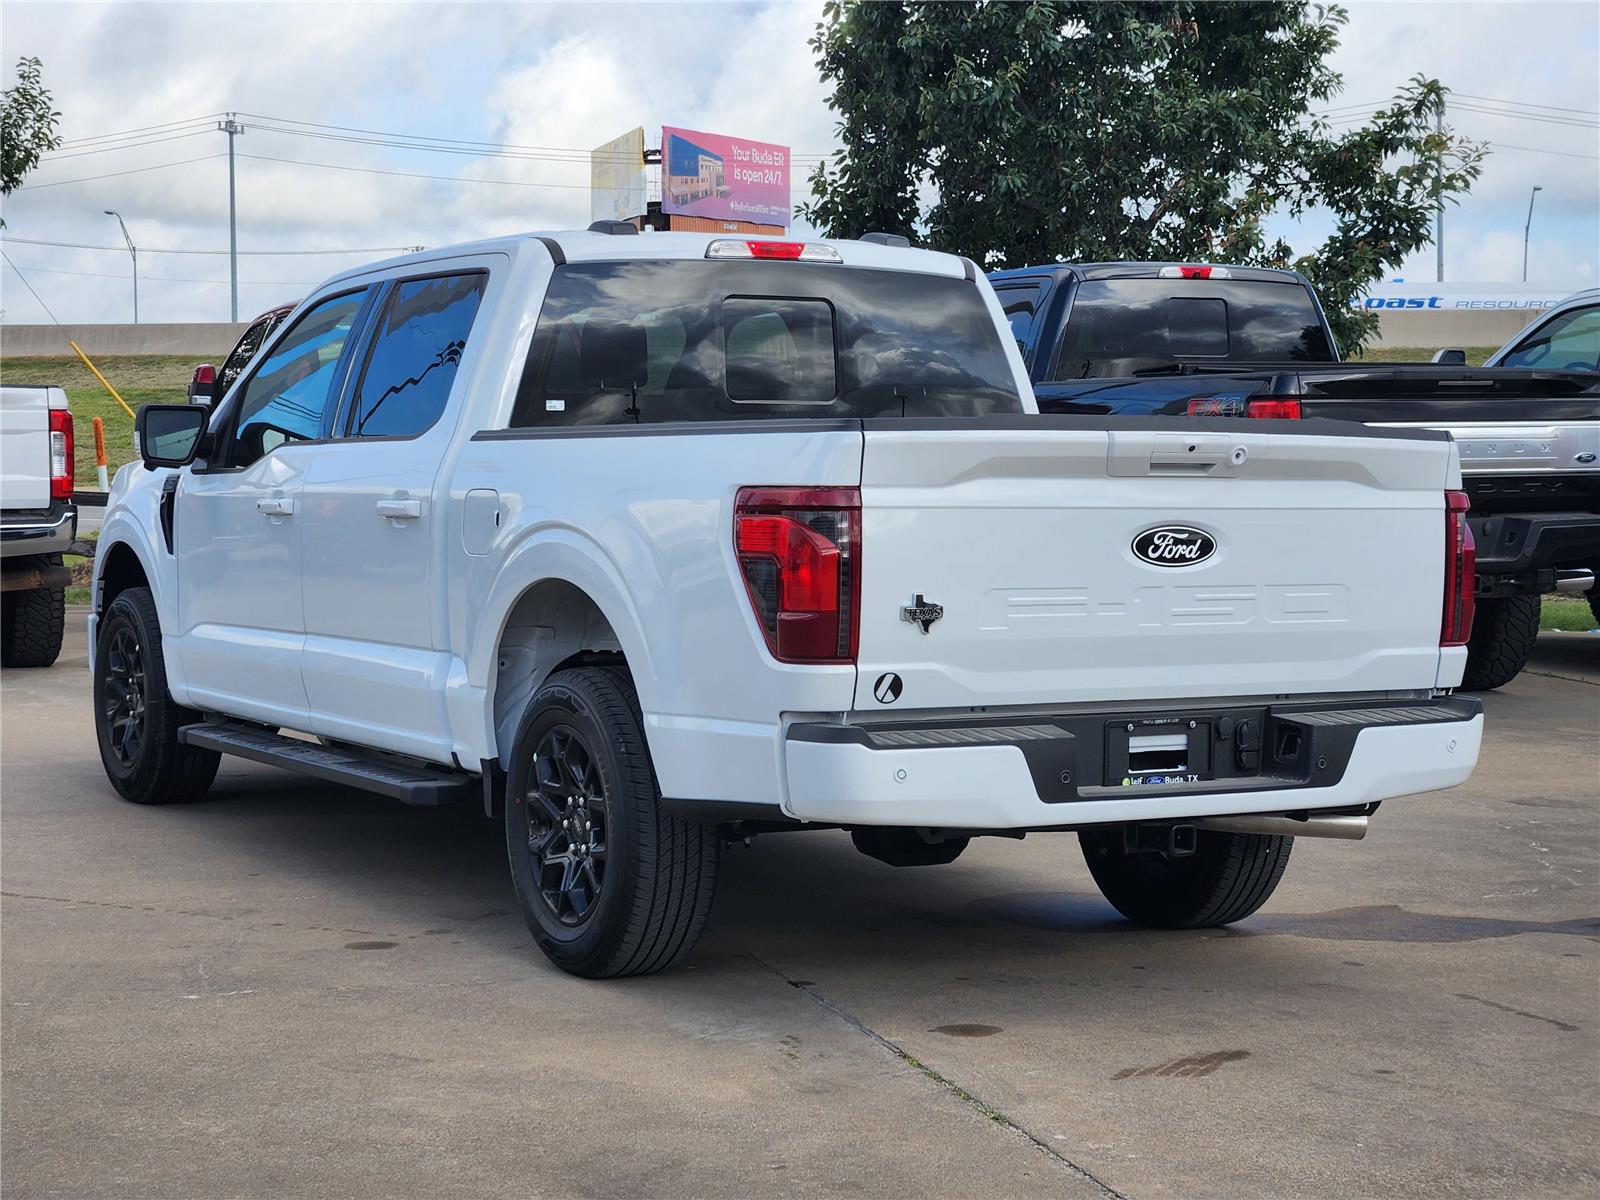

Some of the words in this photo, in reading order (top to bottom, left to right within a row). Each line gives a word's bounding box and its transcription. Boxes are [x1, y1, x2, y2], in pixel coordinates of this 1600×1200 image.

[732, 145, 750, 161] Your
[751, 148, 772, 165] Buda
[773, 151, 785, 167] ER
[734, 164, 741, 180] is
[742, 169, 764, 185] open
[764, 169, 783, 187] 24/7.
[1187, 397, 1239, 417] FX4
[1147, 531, 1202, 559] Ford
[904, 607, 942, 619] TEXAS
[978, 584, 1350, 632] F-150
[1187, 775, 1199, 783] TX
